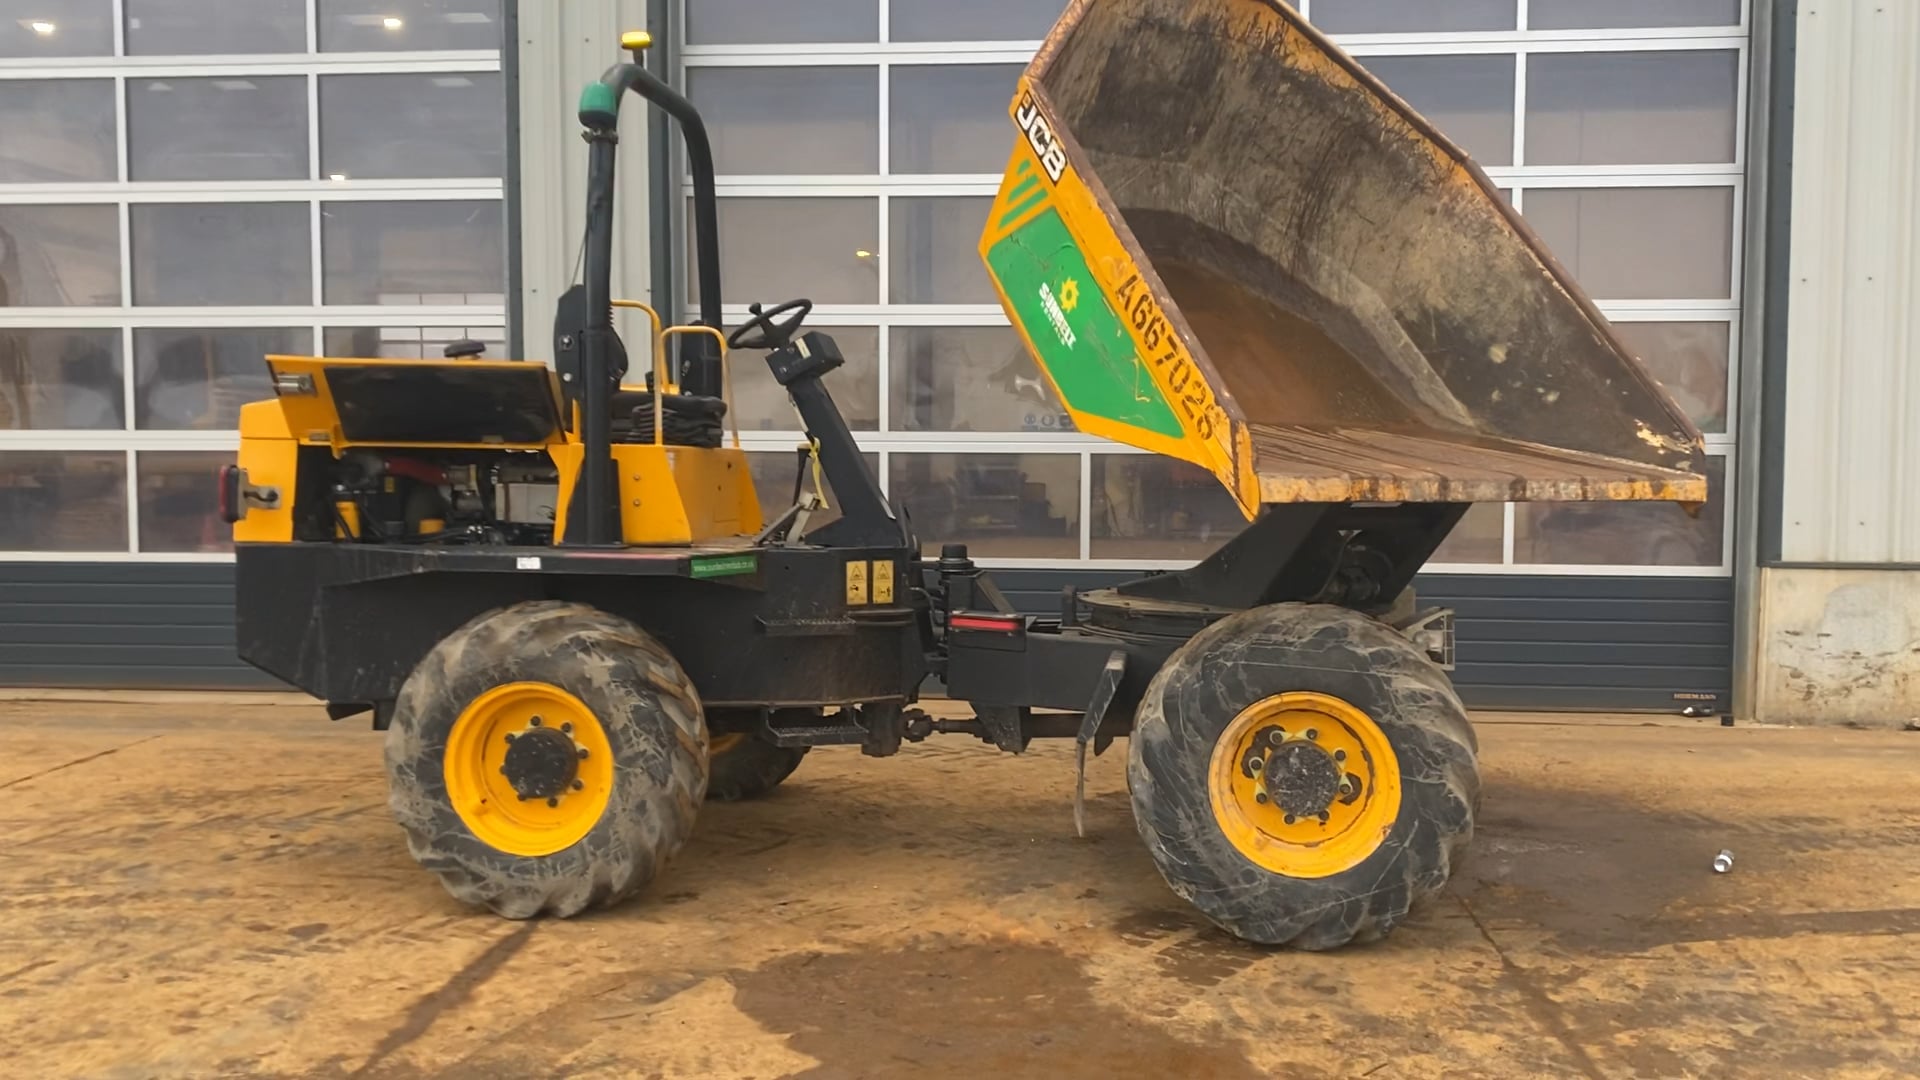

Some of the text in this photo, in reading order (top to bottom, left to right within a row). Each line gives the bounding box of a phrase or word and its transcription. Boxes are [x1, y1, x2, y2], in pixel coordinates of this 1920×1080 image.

[1016, 92, 1067, 182] JCB
[1039, 282, 1077, 351] SUNBELT
[1116, 274, 1217, 440] A667028
